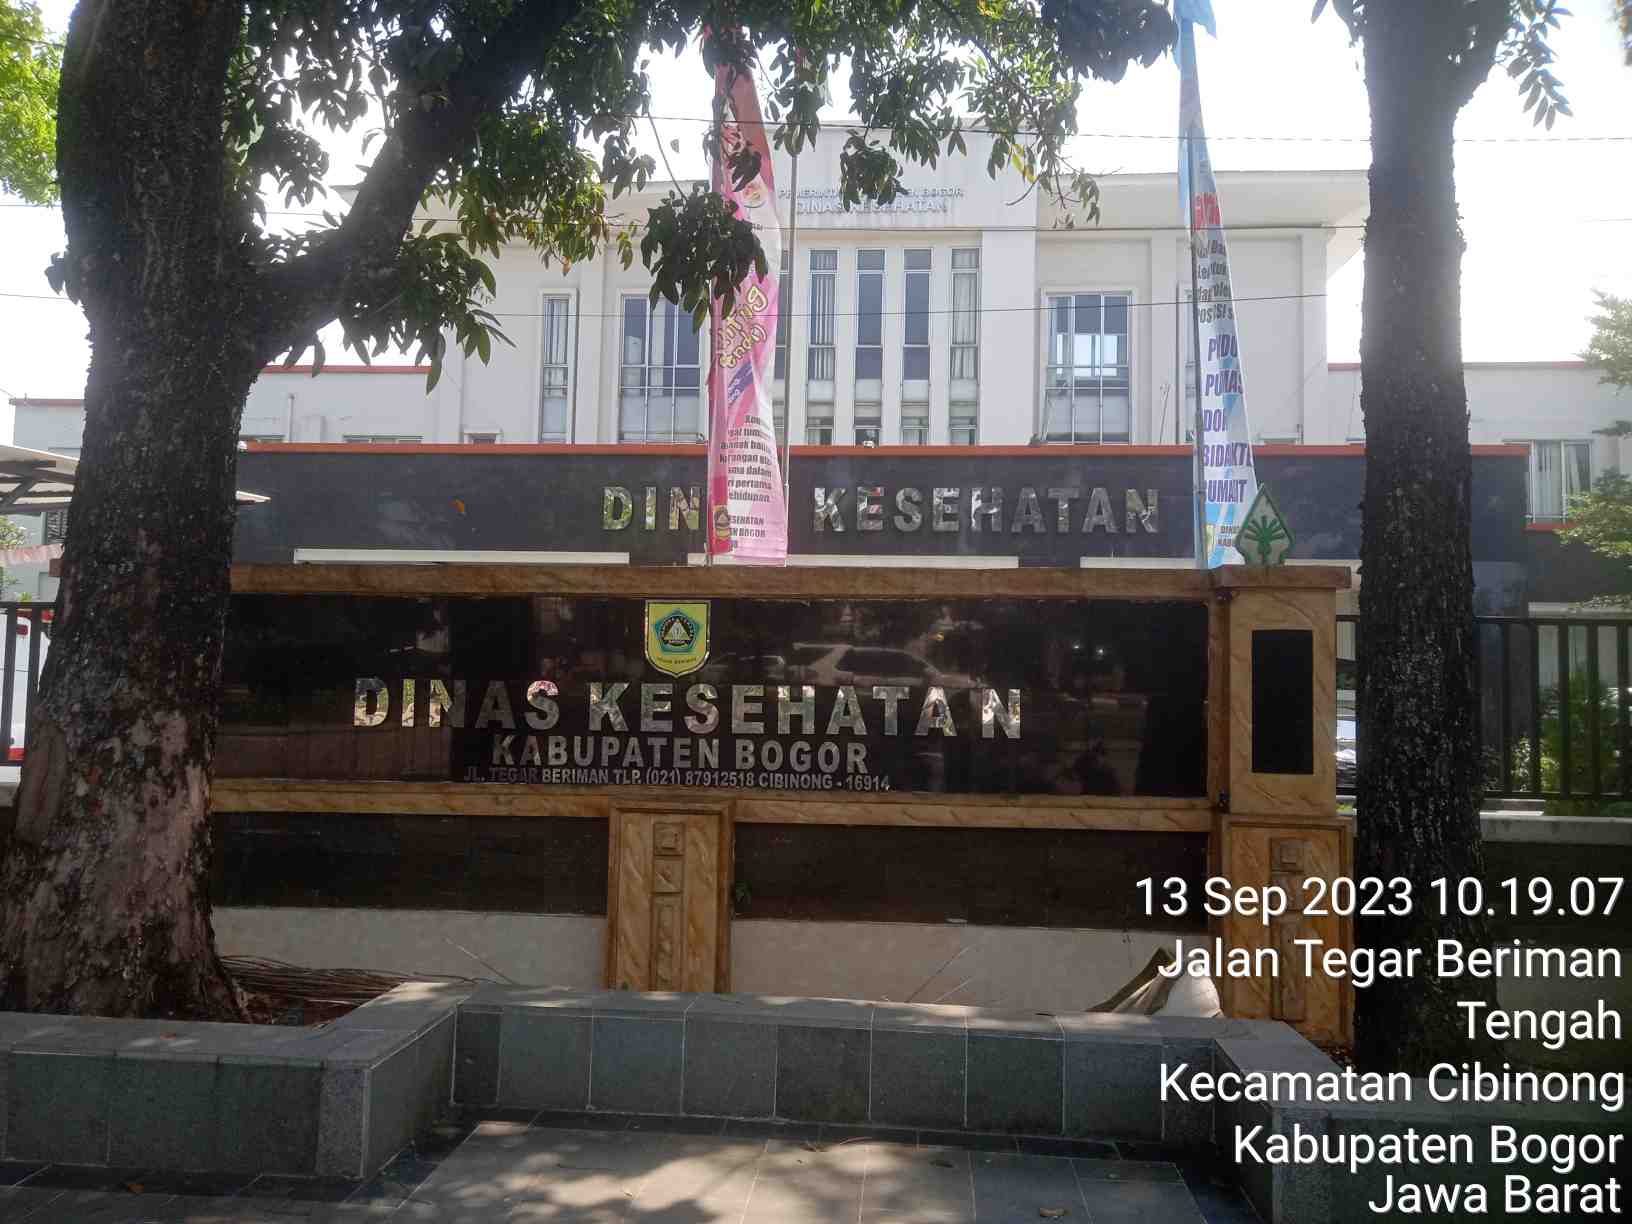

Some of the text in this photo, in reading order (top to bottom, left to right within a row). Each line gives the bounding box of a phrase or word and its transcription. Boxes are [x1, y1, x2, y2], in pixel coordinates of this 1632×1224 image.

[601, 486, 1160, 533] DIN KESEHATAN
[353, 677, 1022, 739] DINAS KESEHATAN
[492, 735, 869, 774] KABUPATEN BOGOR
[464, 766, 486, 781] JL.
[489, 767, 538, 782] TEGAR
[542, 768, 609, 784] BERIMAN
[646, 768, 681, 785] (021)
[685, 771, 755, 787] 87912518
[758, 772, 833, 789] CIBINONG
